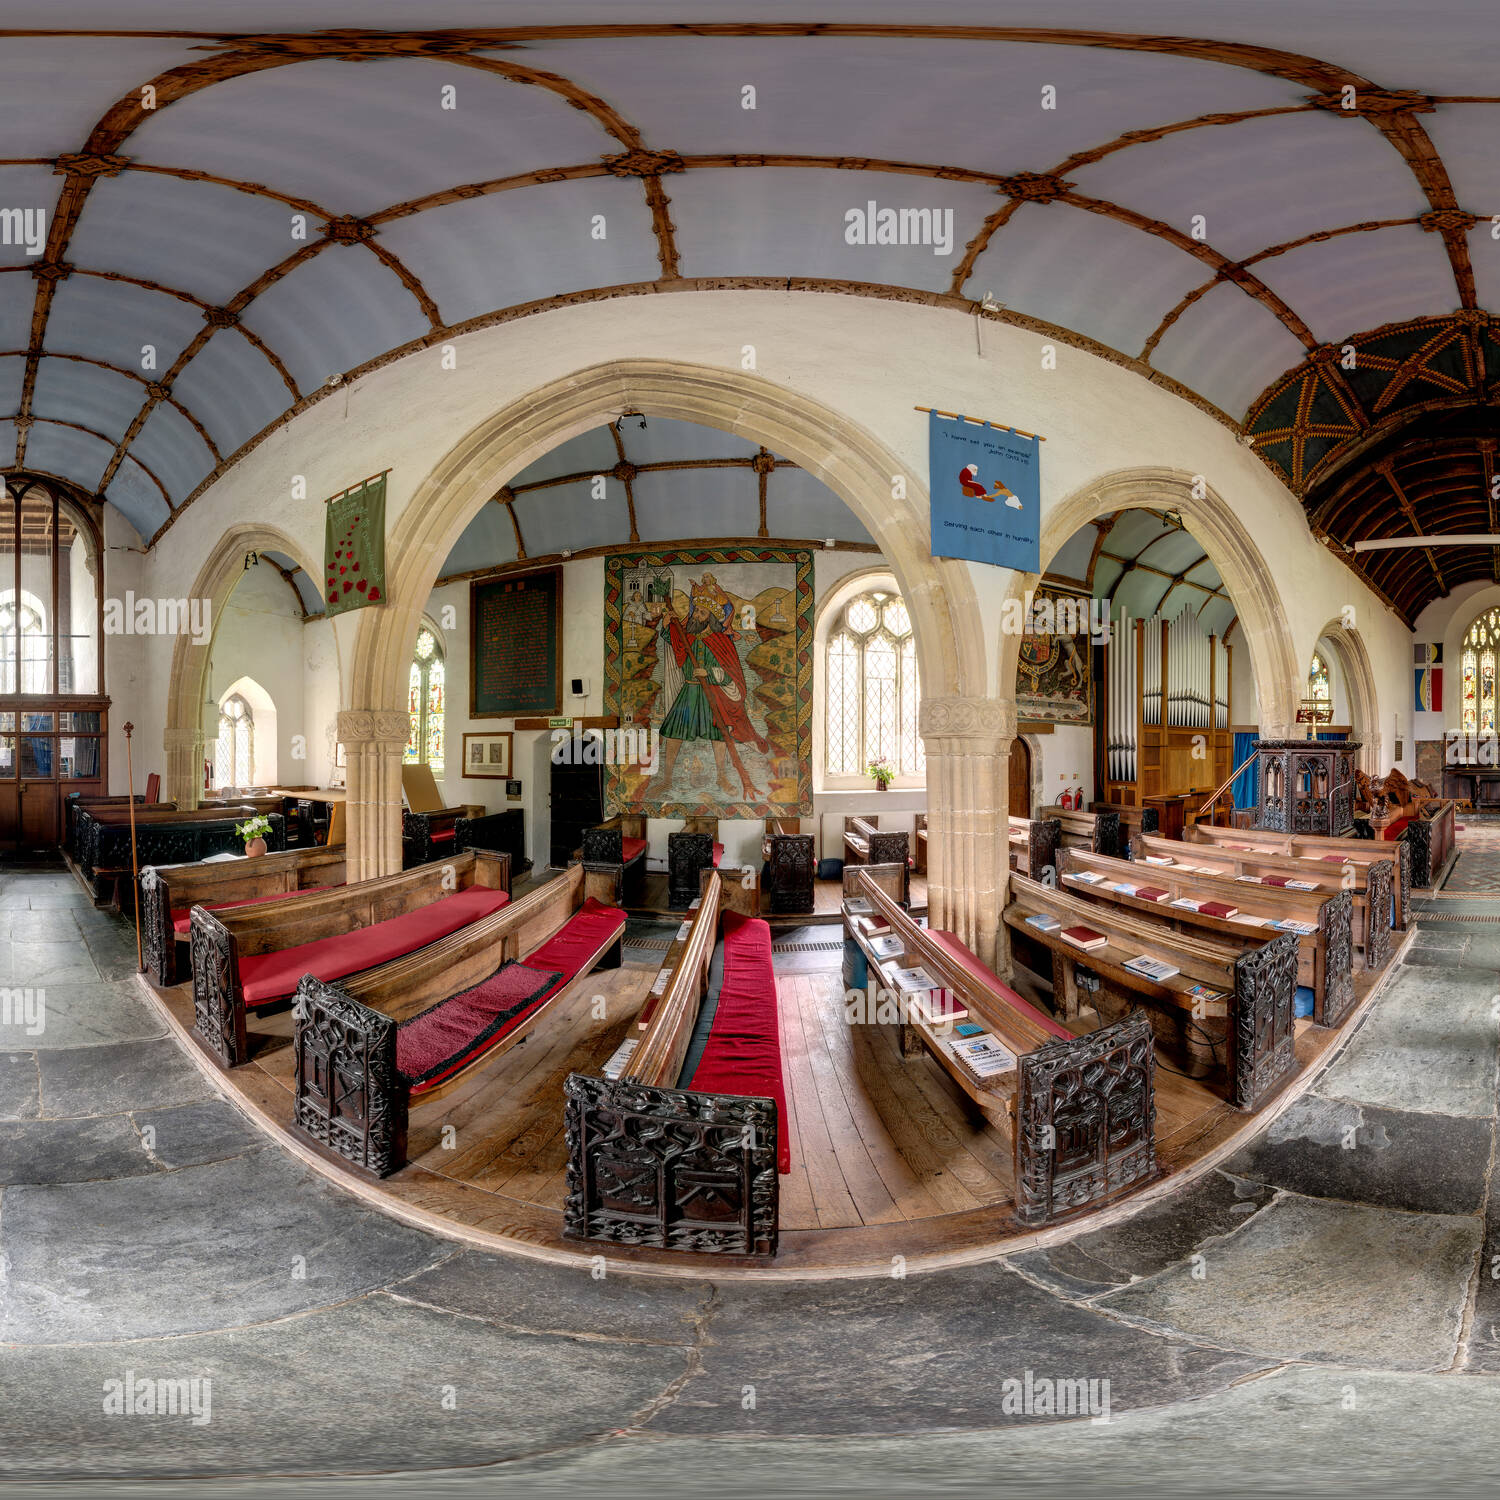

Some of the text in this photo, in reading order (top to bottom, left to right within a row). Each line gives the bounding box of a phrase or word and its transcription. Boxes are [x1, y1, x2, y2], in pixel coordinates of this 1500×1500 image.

[943, 520, 968, 531] Serving
[969, 526, 985, 534] each
[987, 529, 1003, 537] other
